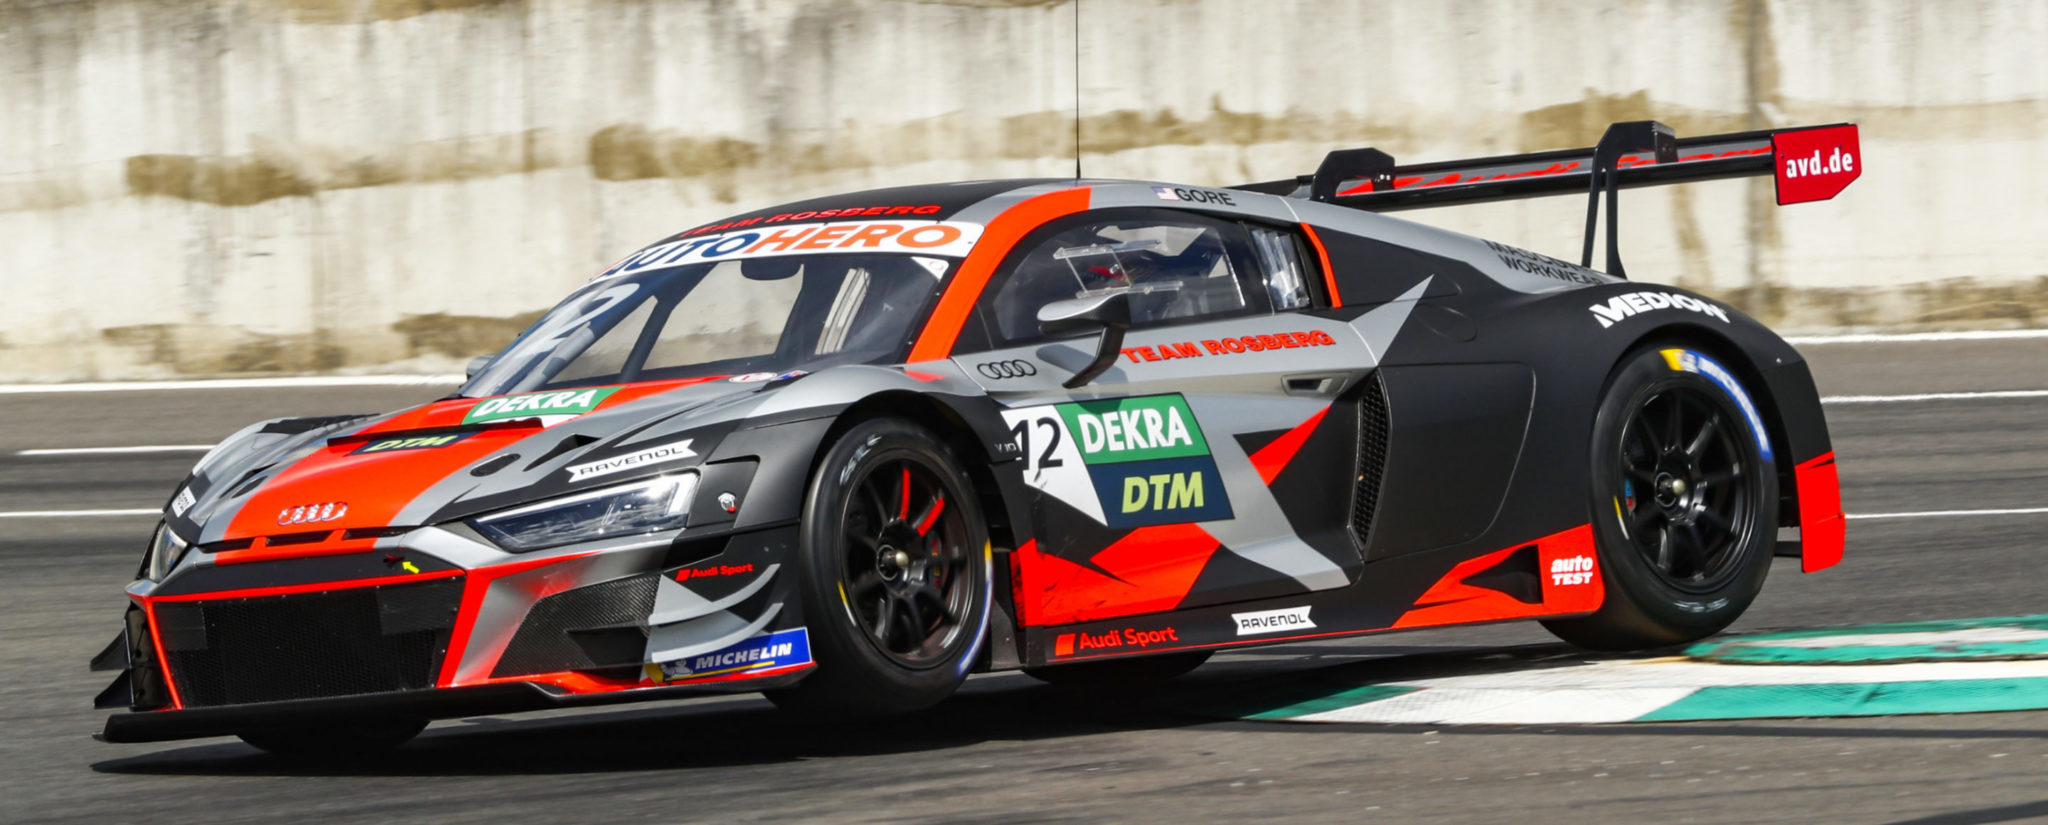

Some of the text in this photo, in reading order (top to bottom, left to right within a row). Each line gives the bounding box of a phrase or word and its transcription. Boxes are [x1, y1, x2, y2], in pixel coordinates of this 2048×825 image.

[1786, 146, 1853, 178] avd.de
[1174, 187, 1237, 206] GORE
[680, 204, 942, 238] TEAM ROSBERG
[1588, 291, 1730, 328] MEDION
[1119, 330, 1336, 364] TEAM ROSBERG
[472, 389, 598, 418] DEKRA
[362, 435, 459, 452] DTM
[1012, 416, 1063, 470] 12
[1078, 406, 1193, 454] DEKRA
[580, 448, 683, 475] RAVENOL
[1121, 471, 1205, 514] DTM
[690, 563, 754, 578] Audi Sport
[1550, 554, 1594, 573] auto
[1551, 572, 1594, 586] TEST
[1241, 613, 1306, 630] RAVENOL
[1079, 626, 1179, 650] Audi Sport
[695, 642, 793, 670] MICHELIN
